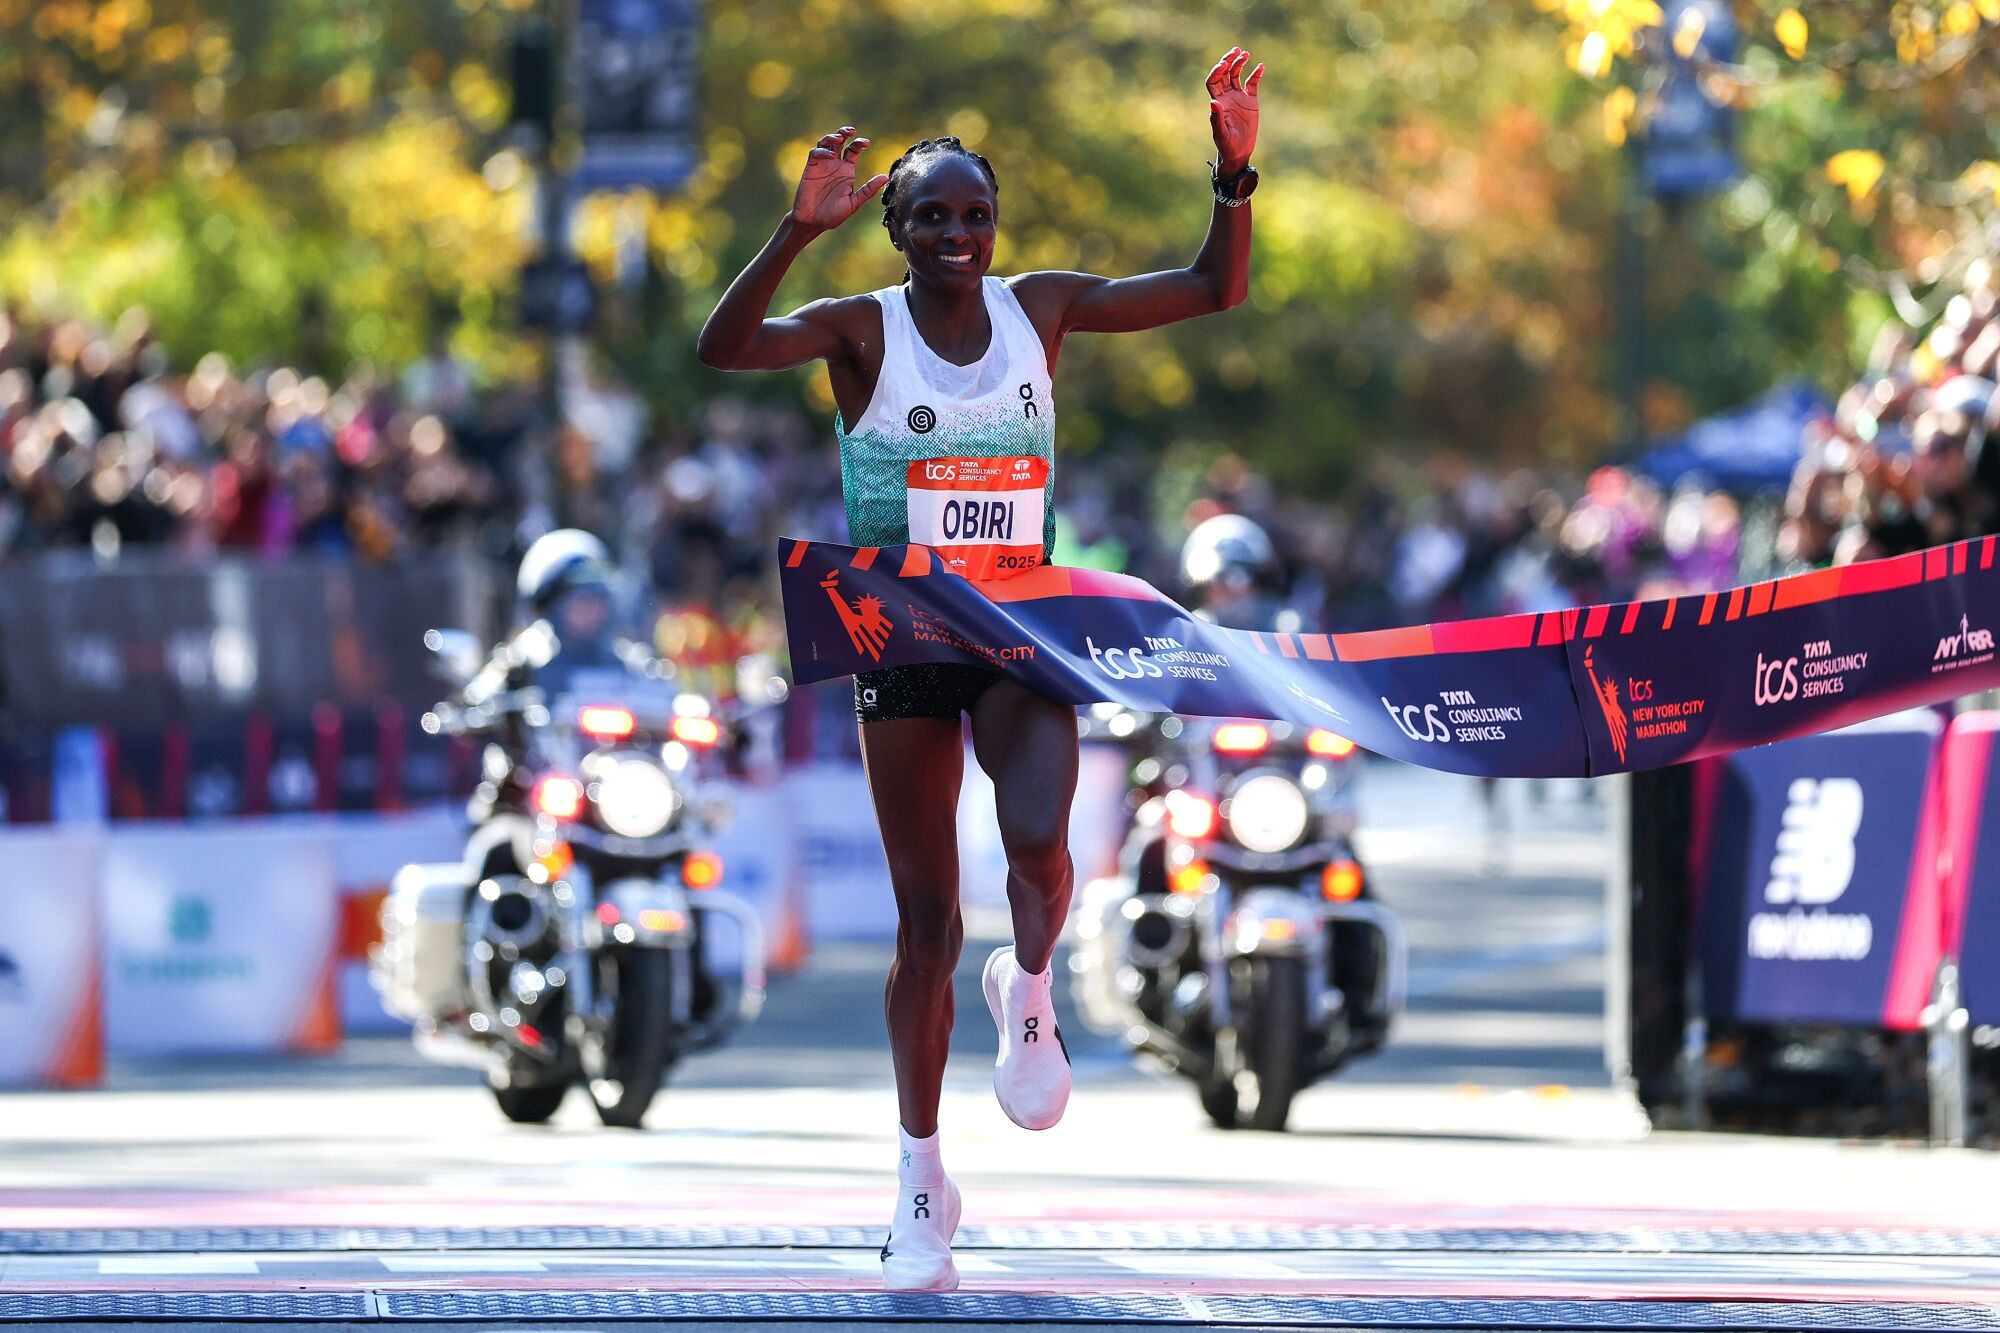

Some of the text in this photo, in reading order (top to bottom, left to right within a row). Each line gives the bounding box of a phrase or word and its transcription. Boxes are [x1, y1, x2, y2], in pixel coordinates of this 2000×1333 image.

[926, 460, 957, 480] tcs
[1011, 472, 1031, 480] TATA
[943, 499, 1014, 540] OBIRI
[997, 555, 1036, 569] 2025
[912, 621, 949, 637] NEW
[1000, 645, 1035, 660] CITY
[1144, 636, 1183, 651] TATA
[1803, 640, 1832, 659] TATA
[1086, 636, 1164, 680] tcs
[1154, 650, 1232, 668] CONSULTANCY
[1803, 652, 1868, 679] CONSULTANCY
[1167, 665, 1217, 682] SERVICES
[1755, 652, 1798, 706] tcs
[1629, 676, 1653, 701] tcs
[1802, 676, 1844, 698] SERVICES
[1439, 690, 1476, 706] TATA
[1381, 696, 1451, 743] tcs
[1448, 706, 1523, 724] CONSULTANCY
[1632, 700, 1705, 722] NEW YORK CITY
[1455, 725, 1506, 742] SERVICES
[1635, 719, 1687, 739] MARATHON
